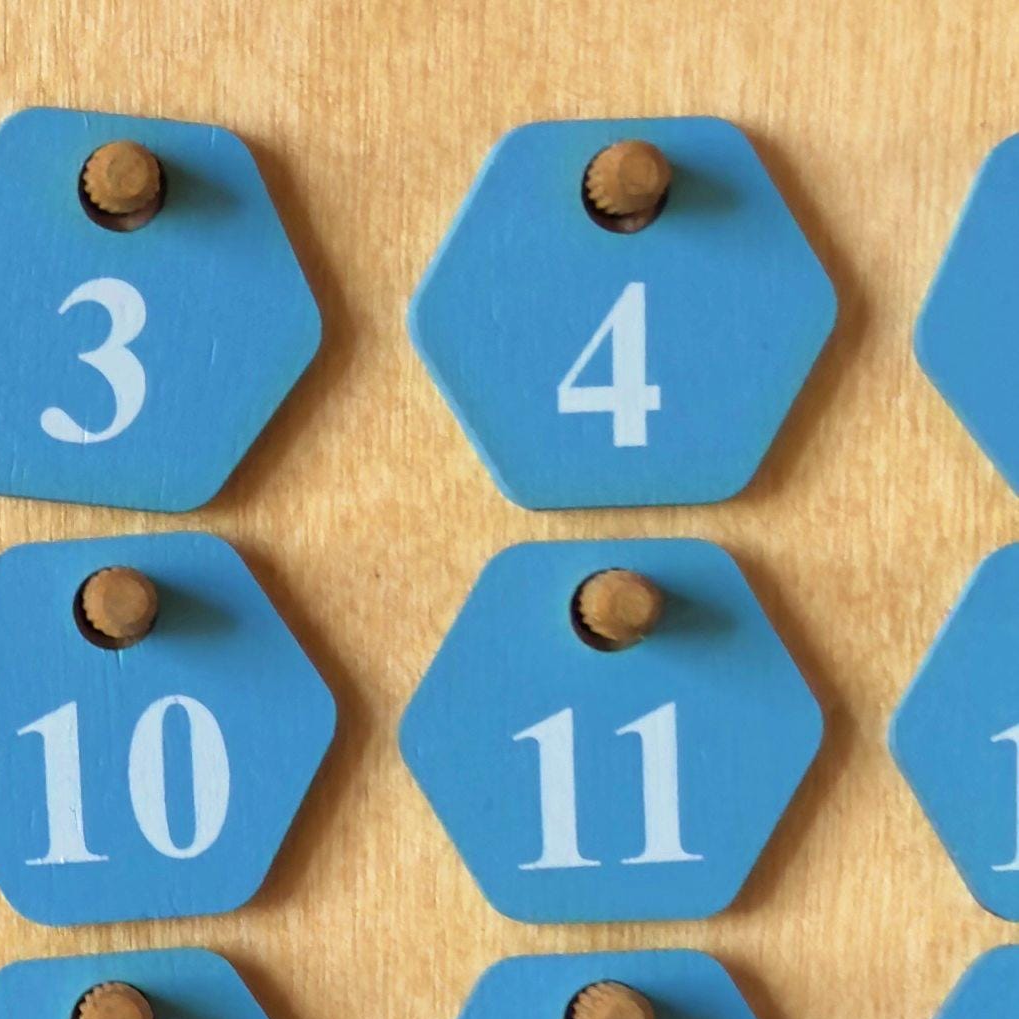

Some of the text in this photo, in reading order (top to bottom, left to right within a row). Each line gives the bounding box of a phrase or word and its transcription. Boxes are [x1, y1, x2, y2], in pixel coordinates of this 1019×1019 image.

[41, 277, 147, 444] 3
[558, 281, 662, 448] 4
[17, 694, 231, 865] 10
[512, 701, 703, 870] 11
